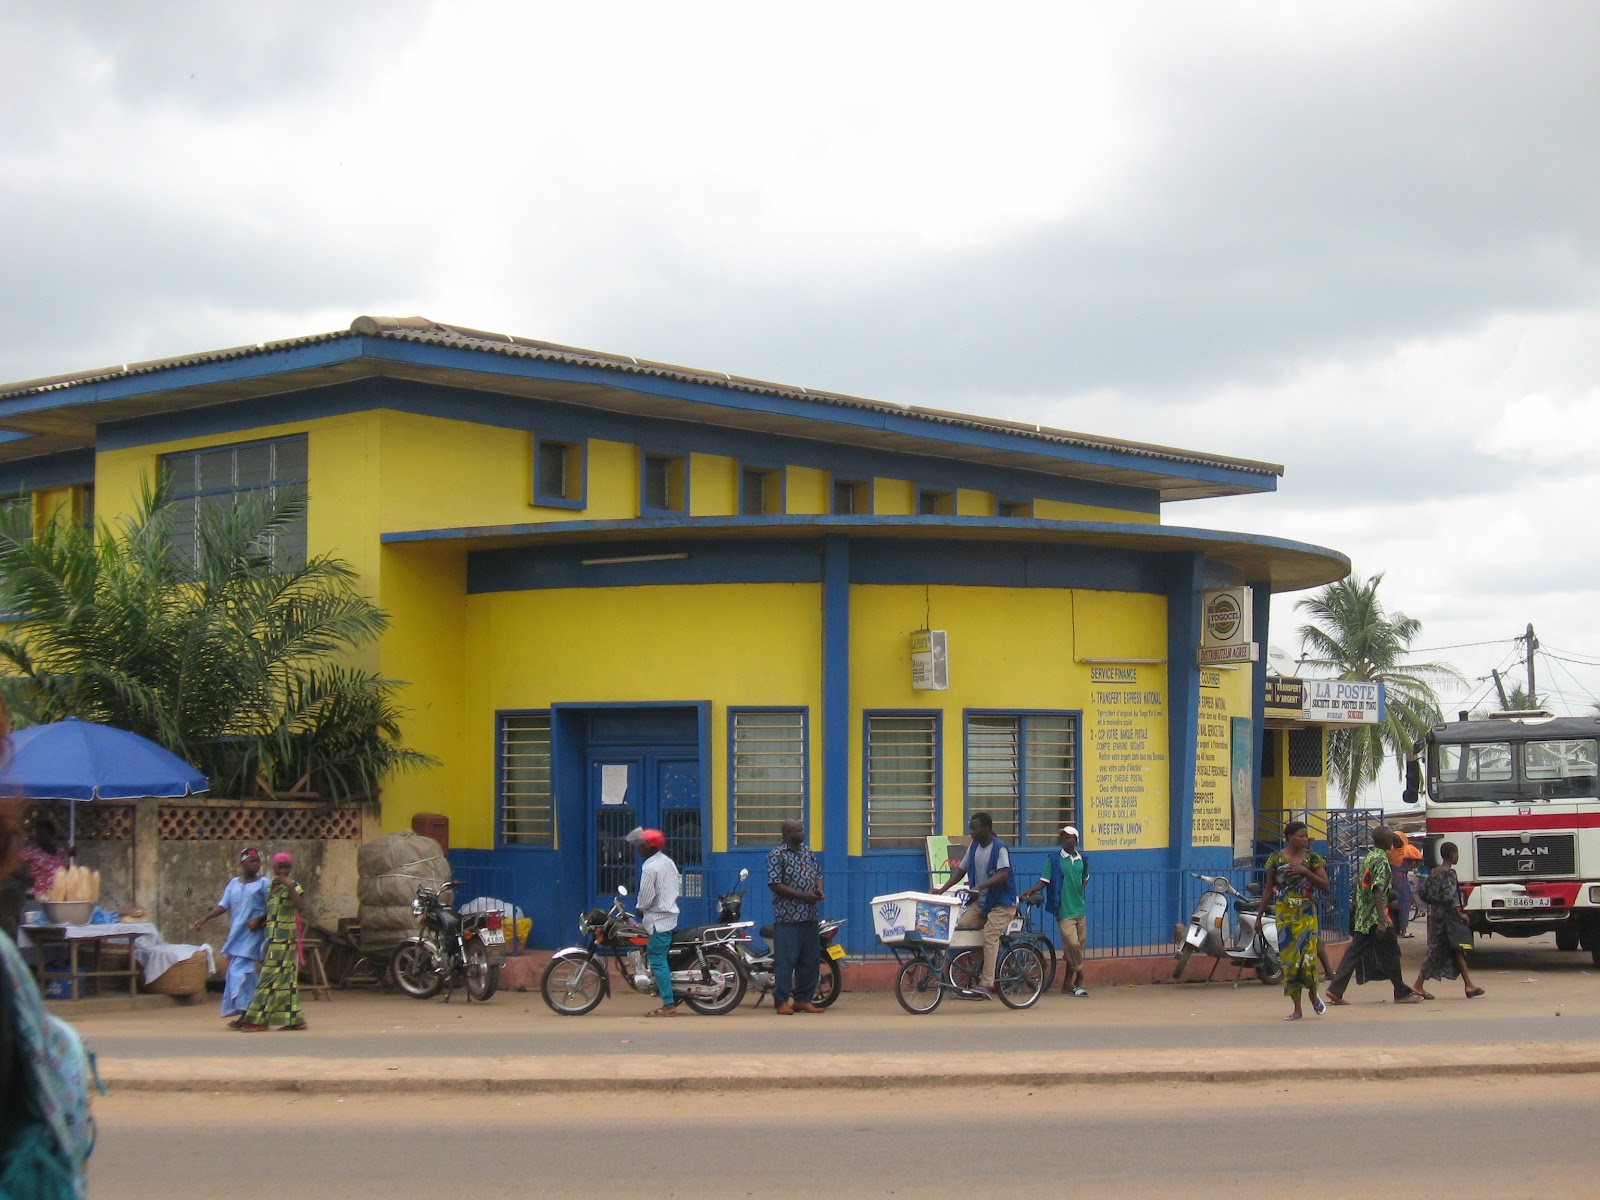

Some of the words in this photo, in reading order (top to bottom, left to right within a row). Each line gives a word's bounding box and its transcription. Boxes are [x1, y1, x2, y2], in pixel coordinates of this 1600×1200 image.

[1211, 612, 1239, 622] TOGOCEL
[1091, 668, 1113, 680] SERVICE
[1115, 668, 1136, 680] FINANCE
[1277, 684, 1302, 692] TRANSFERT
[1316, 683, 1331, 698] LA
[1337, 685, 1374, 700] POSTE
[1097, 692, 1121, 704] TRANSFERT
[1124, 692, 1142, 704] EXPRESS
[1098, 822, 1124, 835] WESTERN
[1126, 822, 1142, 835] UNION
[1513, 898, 1534, 906] 8469
[1539, 898, 1550, 906] AJ
